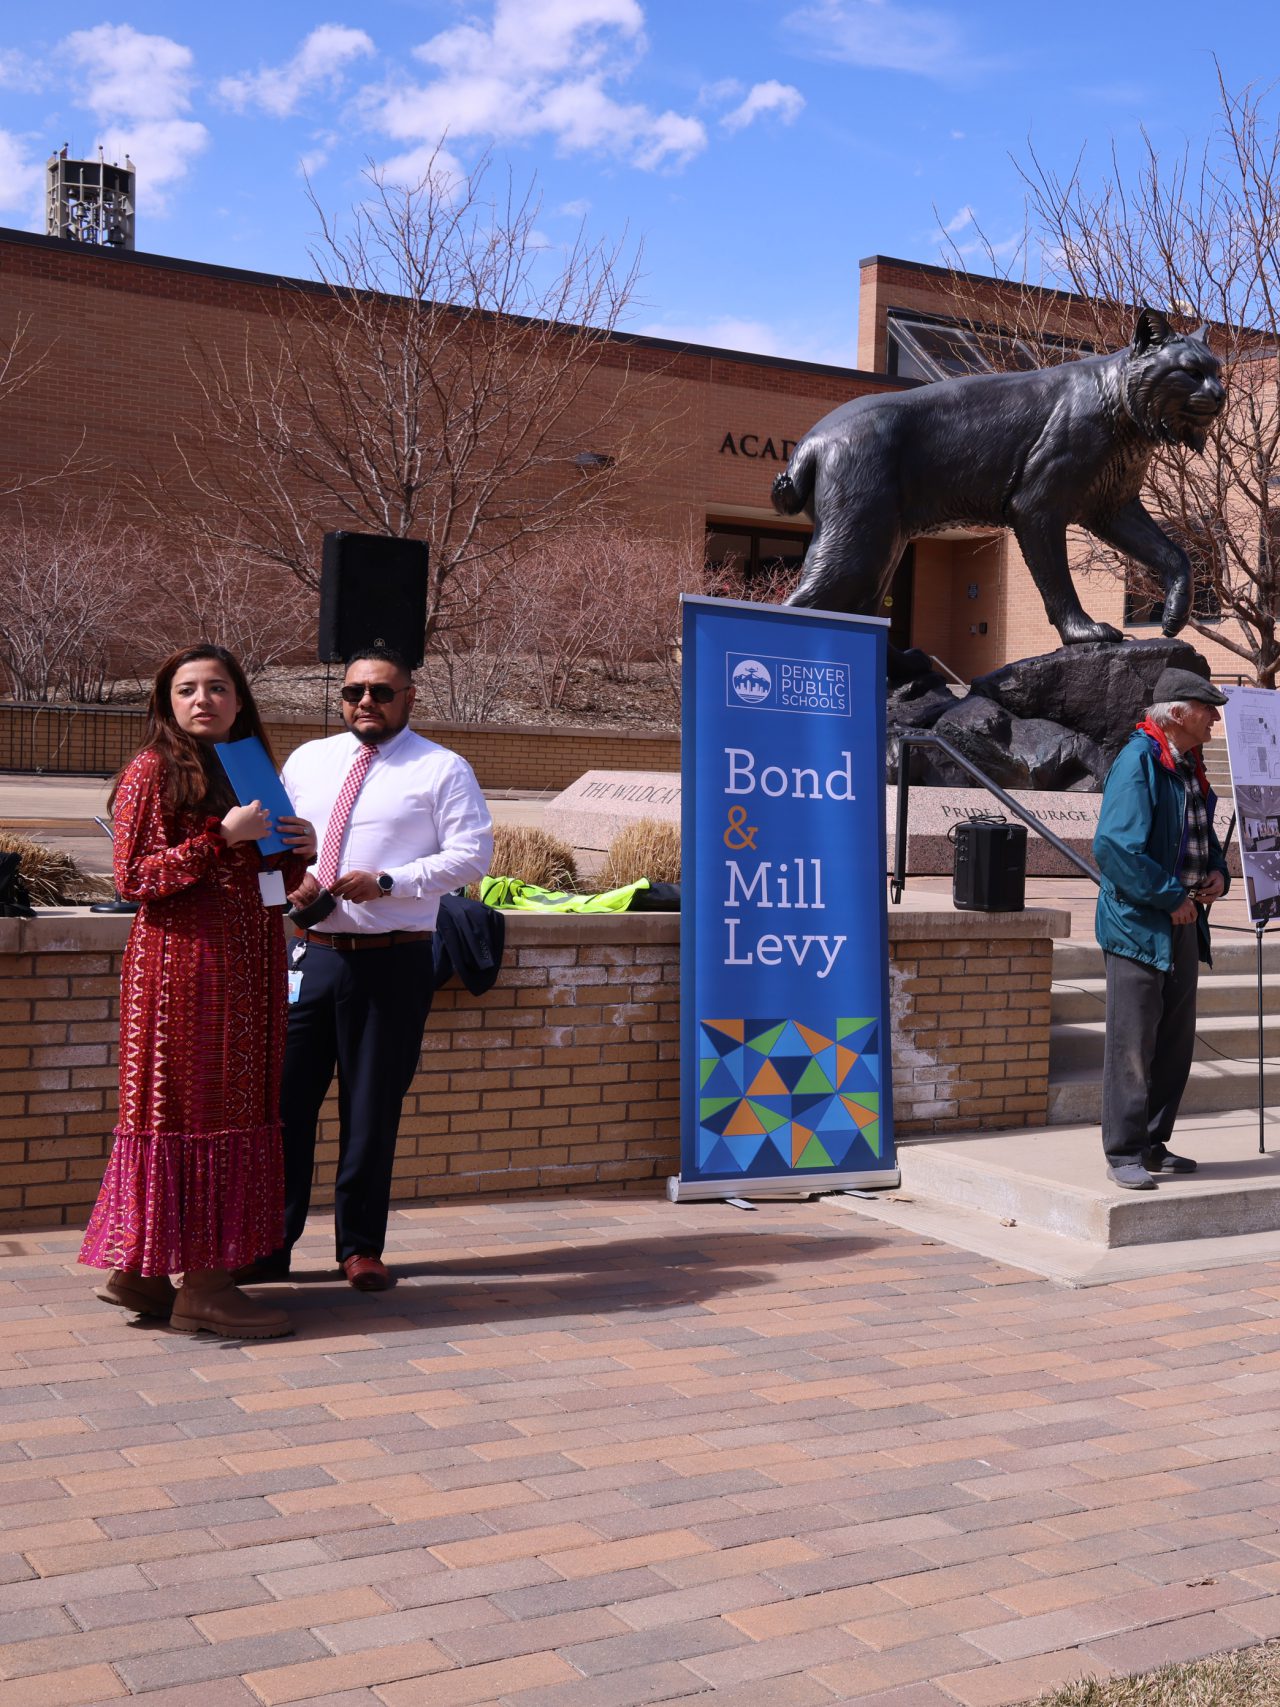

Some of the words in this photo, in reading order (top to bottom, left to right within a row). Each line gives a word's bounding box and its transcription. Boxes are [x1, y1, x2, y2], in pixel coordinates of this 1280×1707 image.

[781, 664, 845, 683] DENVER
[781, 679, 845, 698] PUBLIC
[781, 694, 846, 710] SCHOOLS
[724, 747, 856, 801] Bond
[580, 782, 615, 799] THE
[941, 805, 993, 819] PRIDE
[723, 805, 758, 850] &
[723, 857, 826, 909] Mill
[723, 918, 848, 979] Levy
